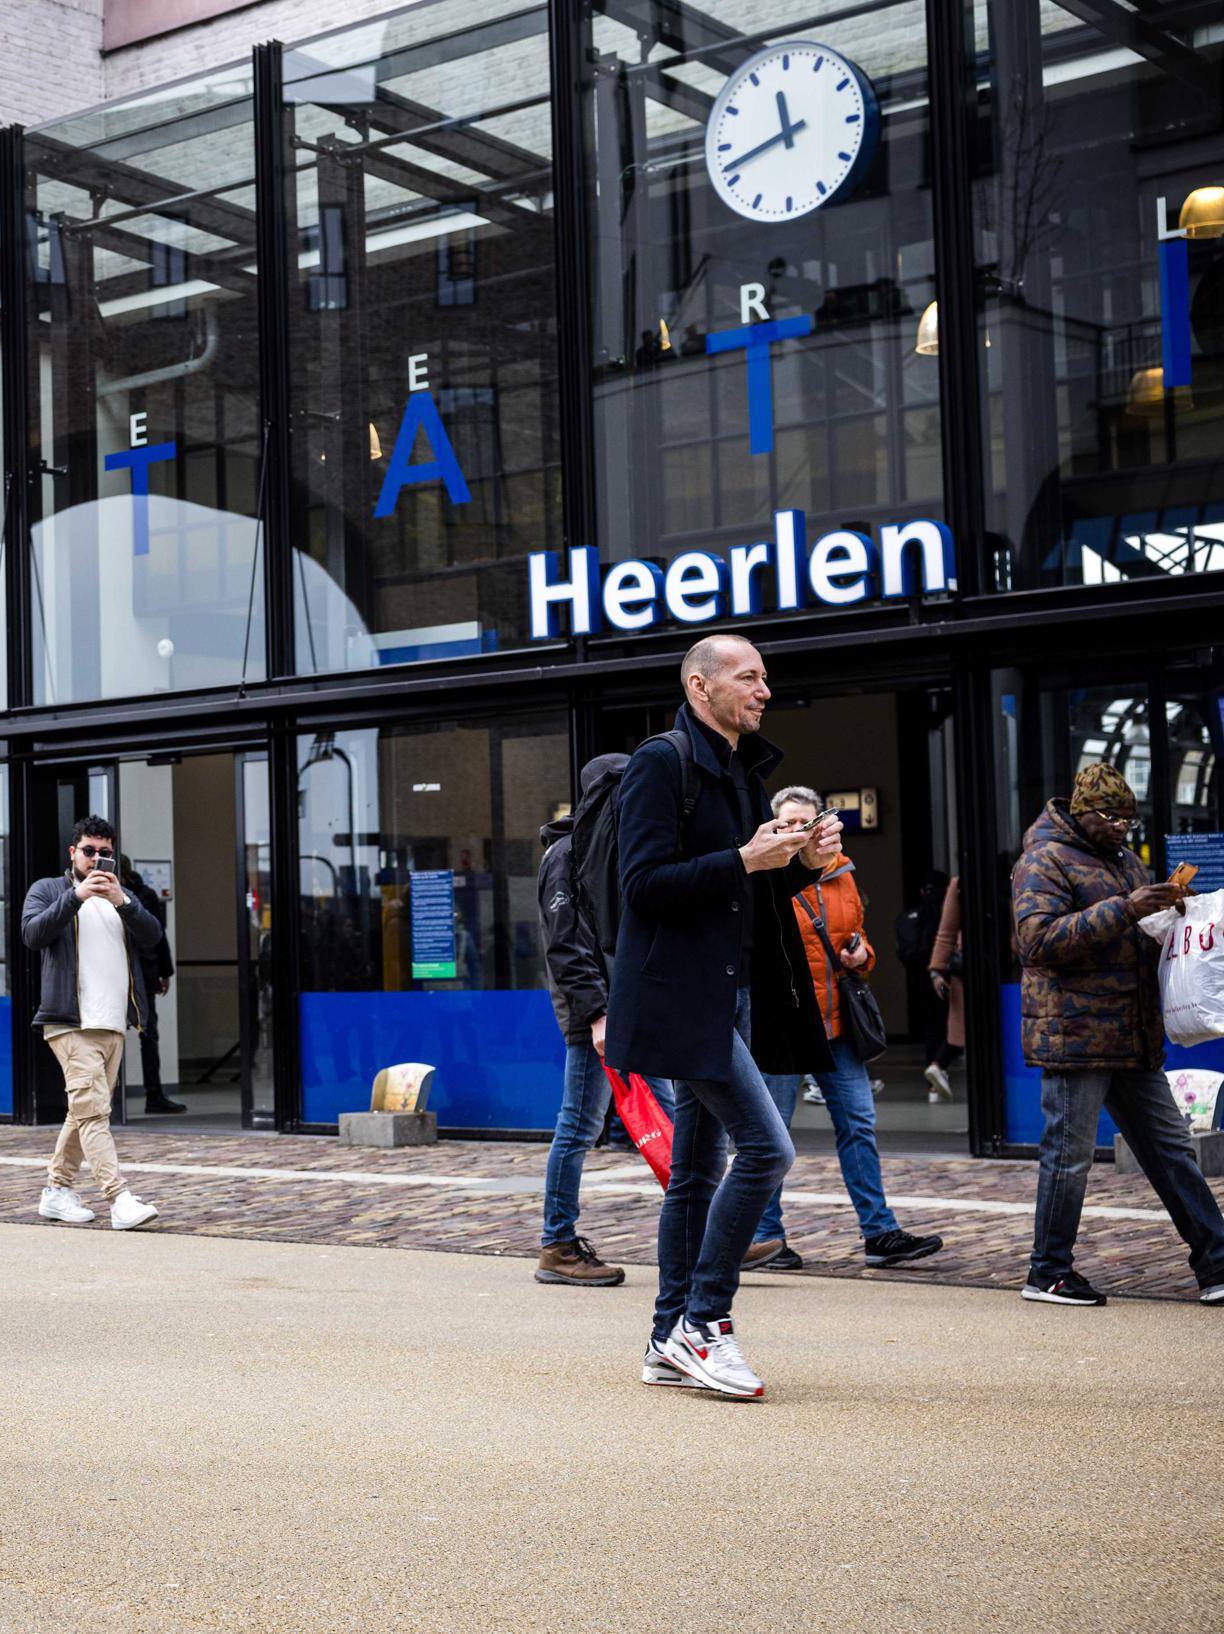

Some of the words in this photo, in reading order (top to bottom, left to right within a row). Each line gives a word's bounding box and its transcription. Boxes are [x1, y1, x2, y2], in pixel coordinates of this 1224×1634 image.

[740, 282, 771, 324] R
[408, 353, 429, 391] E
[130, 411, 148, 448] E
[373, 391, 473, 518] A
[528, 508, 956, 640] Heerlen
